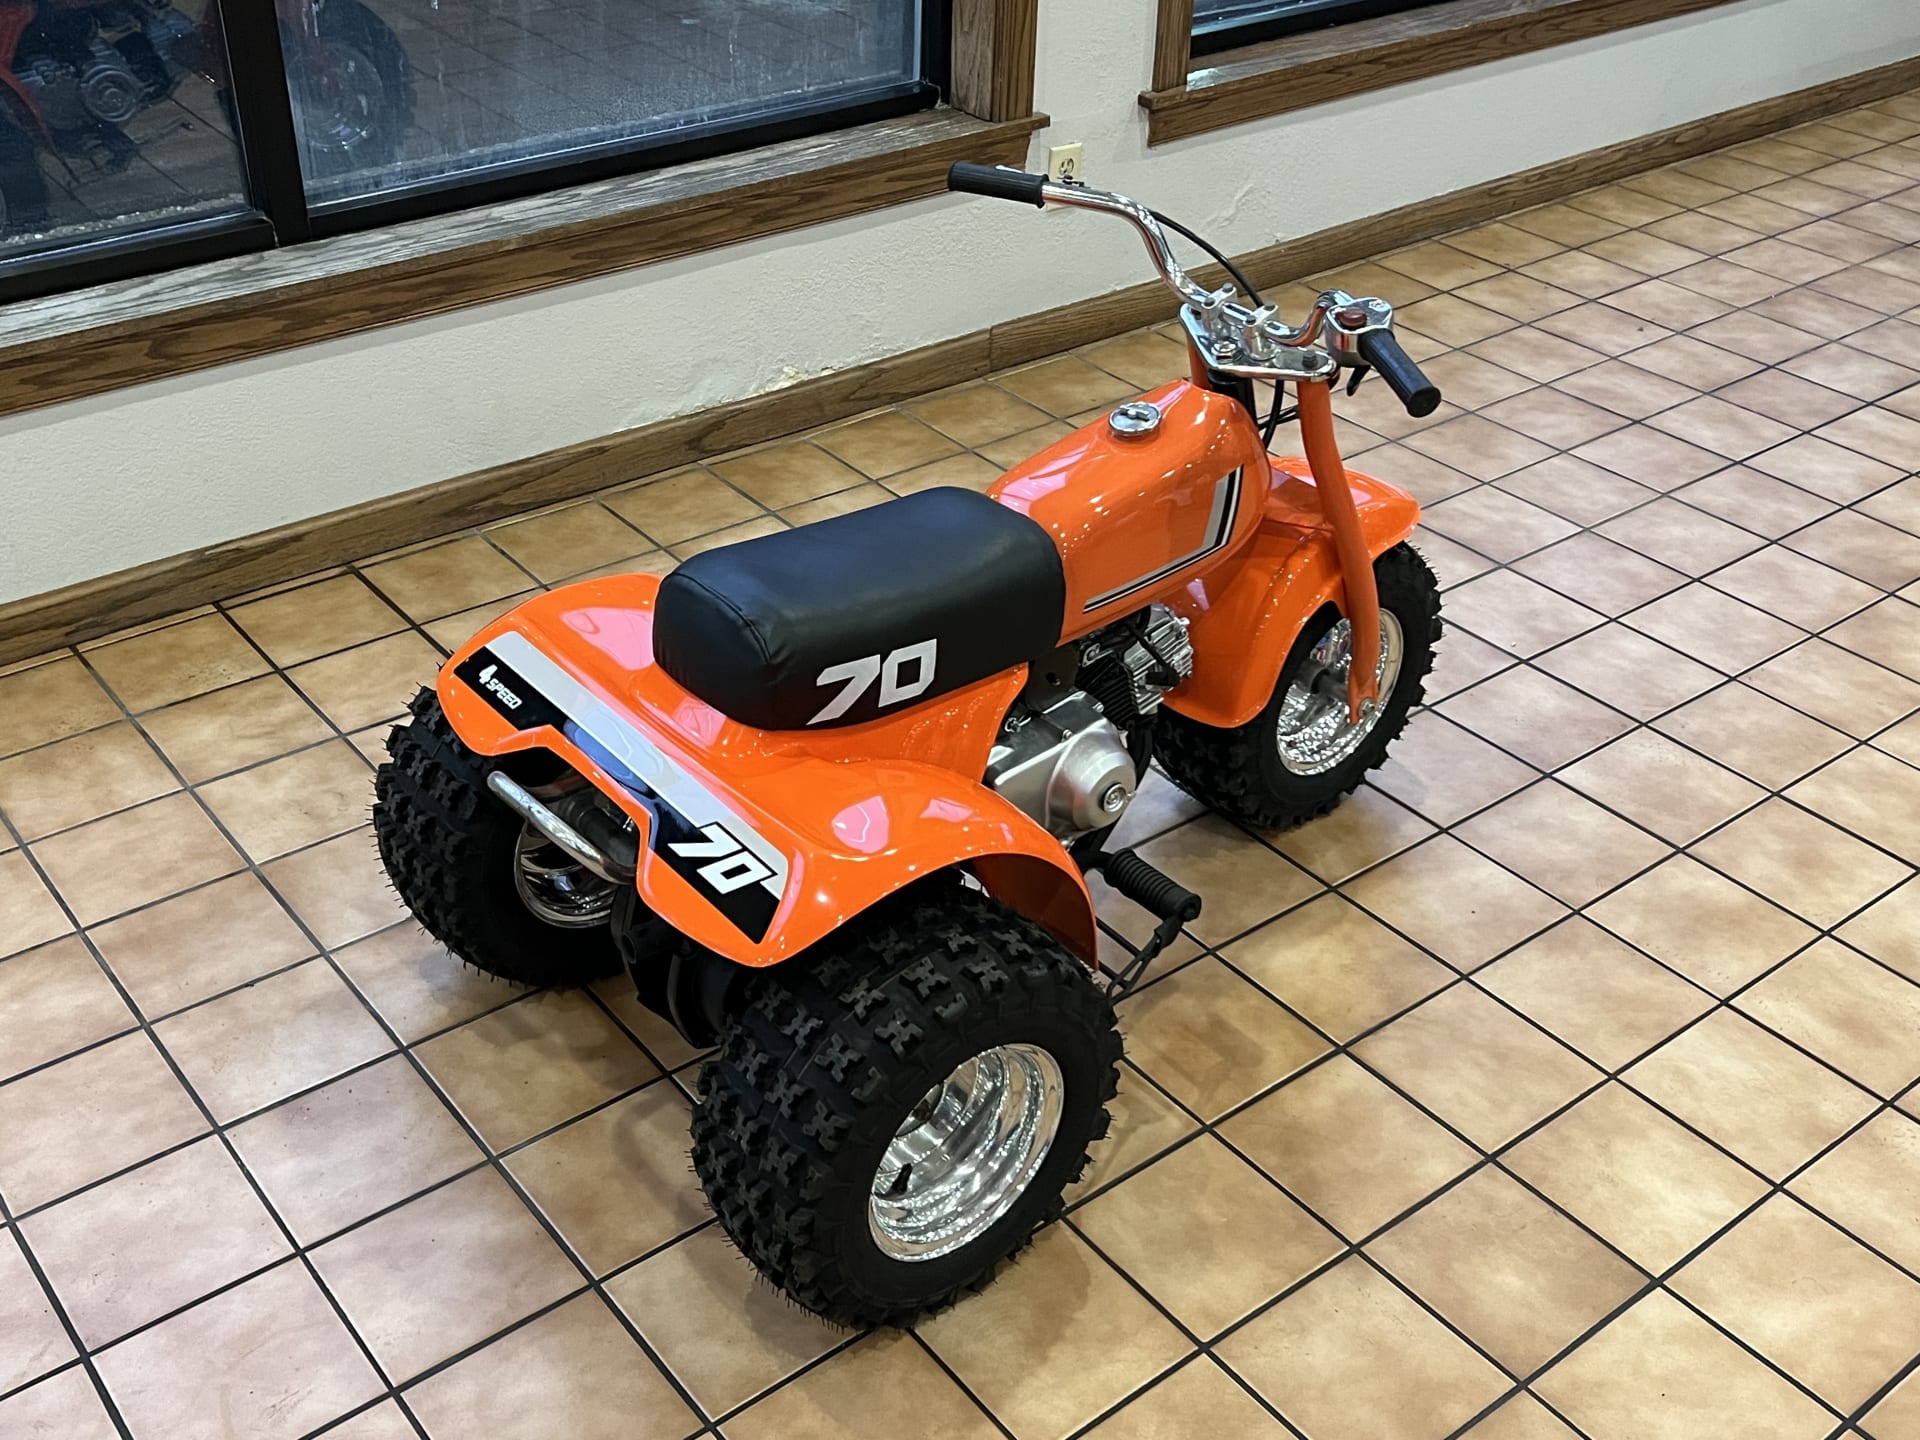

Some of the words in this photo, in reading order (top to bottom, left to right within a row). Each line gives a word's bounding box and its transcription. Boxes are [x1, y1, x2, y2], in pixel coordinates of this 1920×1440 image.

[479, 664, 498, 685] 4
[486, 678, 523, 710] SPEED
[806, 638, 937, 726] 70
[667, 822, 775, 895] 70
